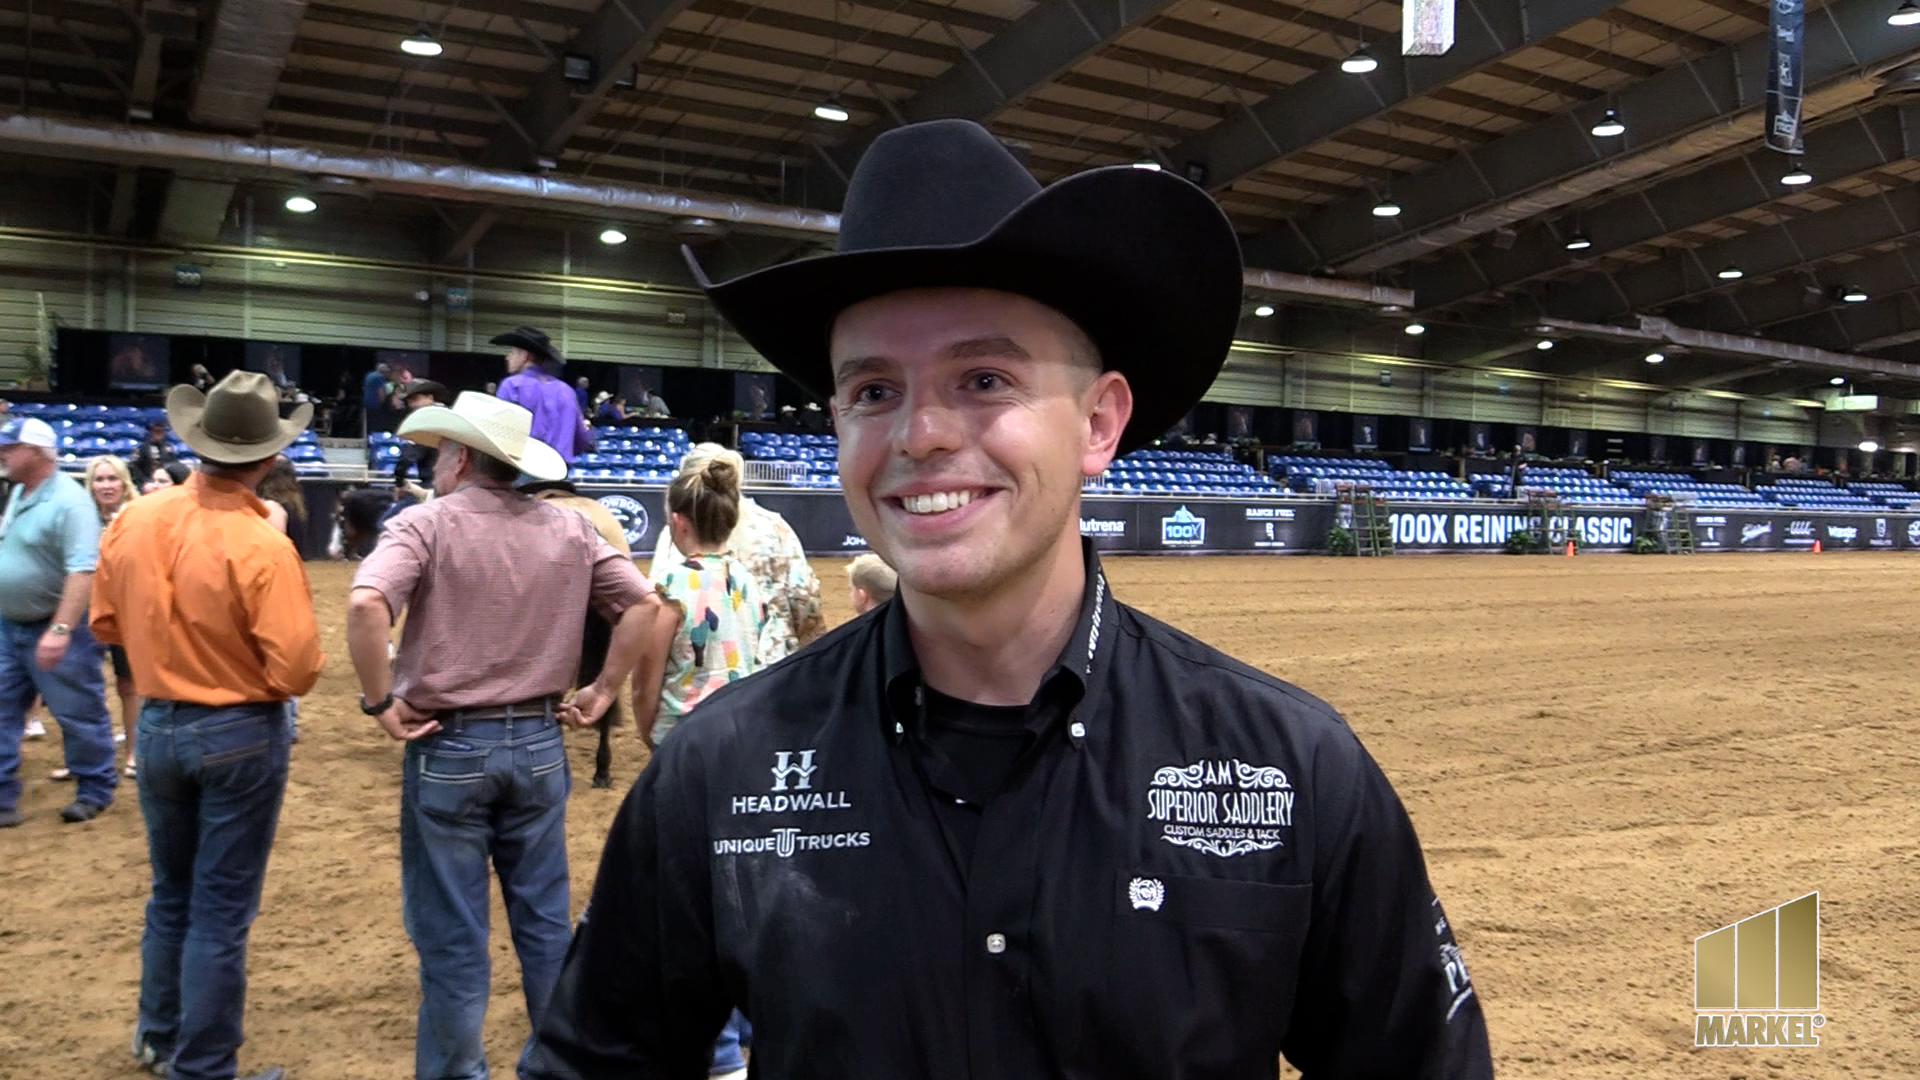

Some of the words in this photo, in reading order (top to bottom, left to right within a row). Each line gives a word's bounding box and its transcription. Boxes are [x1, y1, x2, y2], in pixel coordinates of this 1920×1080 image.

[599, 497, 643, 514] OWBOY
[1389, 513, 1448, 544] 100X
[842, 535, 867, 546] JOH
[1203, 760, 1233, 785] AM
[732, 791, 852, 814] HEADWALL
[1147, 789, 1219, 824] SUPERIOR
[1223, 791, 1294, 826] SADDLERY
[714, 837, 776, 855] UNIQUE
[796, 832, 871, 850] TRUCKS
[1164, 824, 1205, 837] CUSTOM
[1206, 827, 1246, 839] SADDLES
[1247, 828, 1254, 839] &
[1255, 829, 1280, 840] TACK
